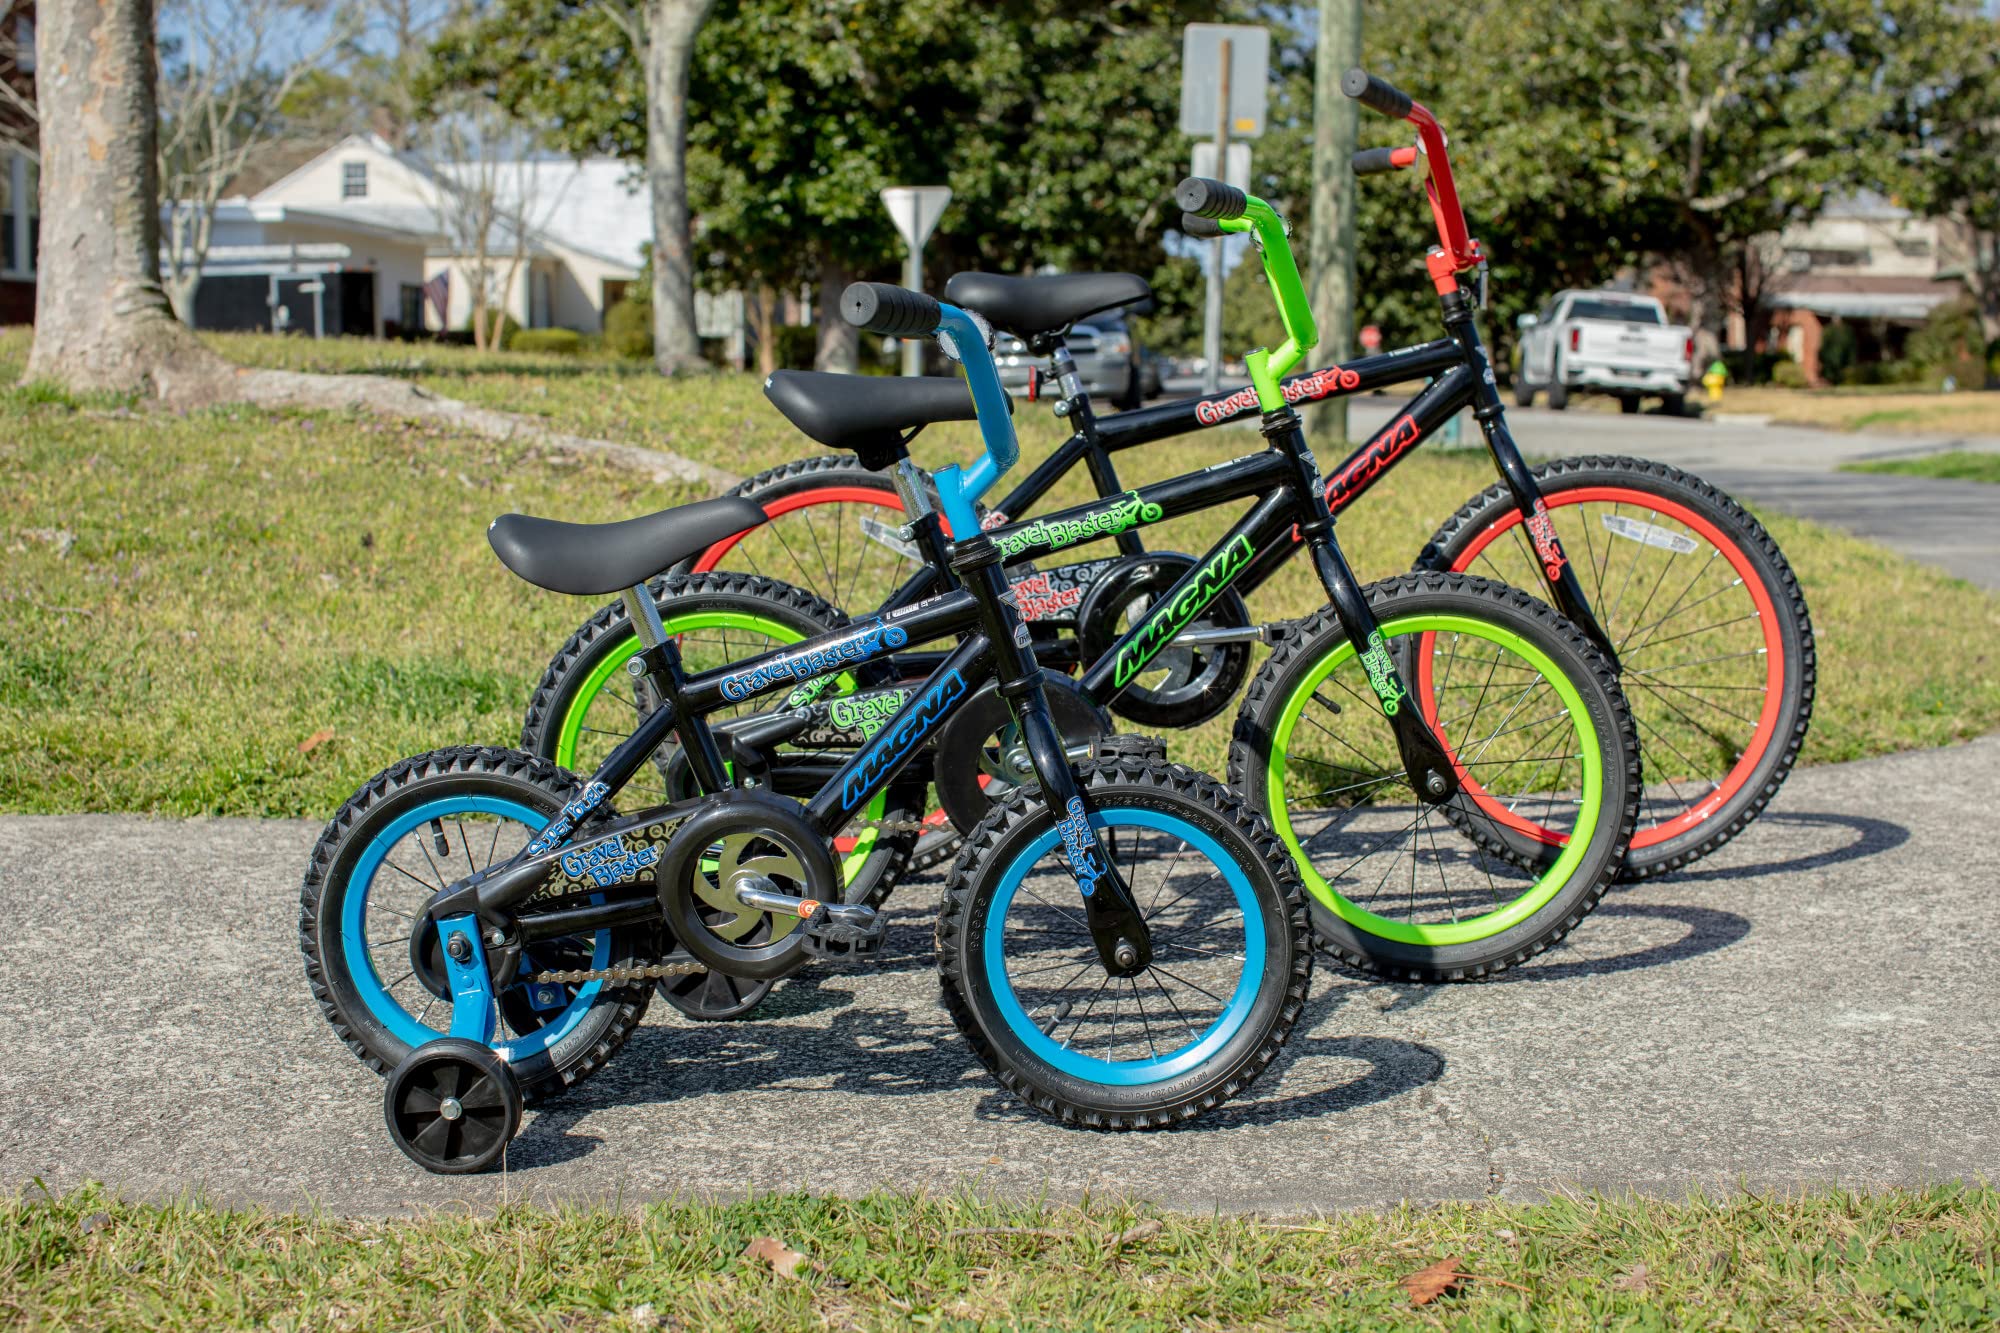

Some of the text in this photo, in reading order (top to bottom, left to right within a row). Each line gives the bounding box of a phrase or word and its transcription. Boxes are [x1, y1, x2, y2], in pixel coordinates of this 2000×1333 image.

[1292, 414, 1419, 543] AGNA
[990, 509, 1120, 562] ravelBlaster
[1009, 572, 1050, 600] avel
[1115, 534, 1254, 688] MAGNA
[829, 689, 904, 730] Gravel
[842, 668, 967, 811] MAGNA
[527, 781, 612, 856] Super Tough
[1066, 796, 1097, 848] Gravel
[560, 834, 627, 878] Gravel
[588, 844, 659, 887] Blaster
[1166, 1084, 1178, 1094] TO
[1177, 1069, 1209, 1090] INFLATE
